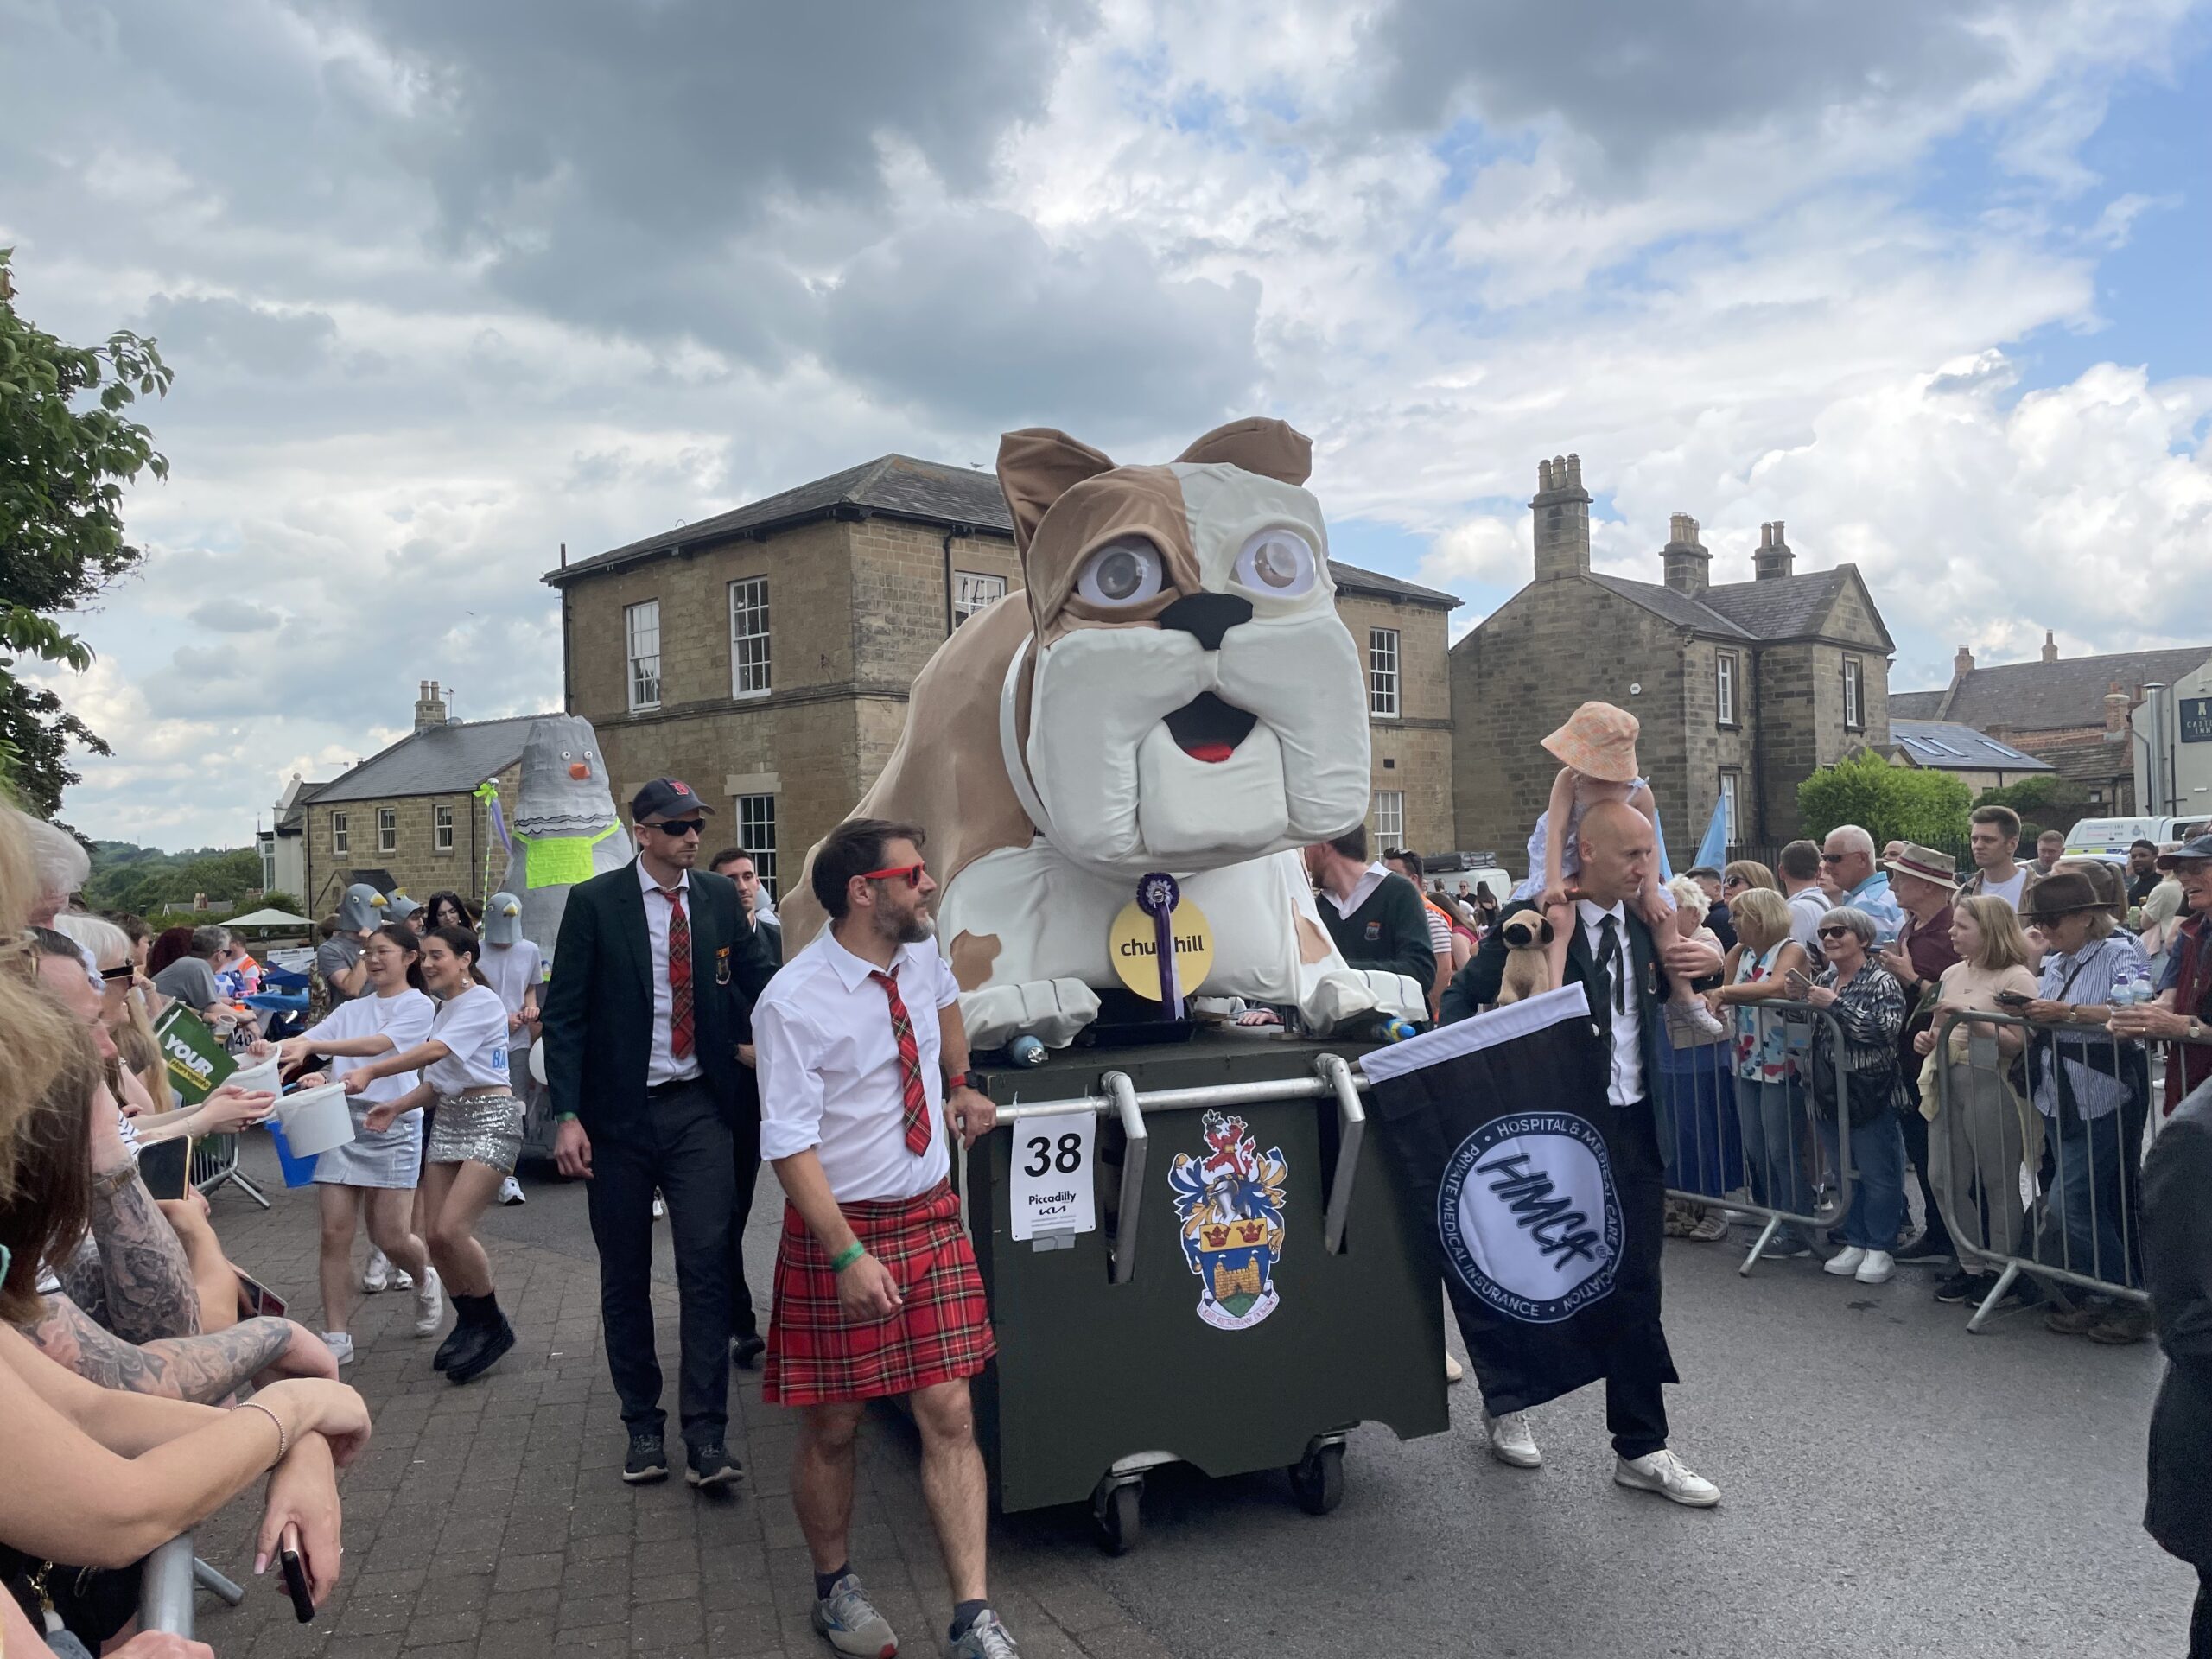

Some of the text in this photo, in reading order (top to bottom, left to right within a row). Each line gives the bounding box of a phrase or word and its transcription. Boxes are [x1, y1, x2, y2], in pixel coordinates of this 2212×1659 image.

[1120, 934, 1205, 957] chuhill
[164, 1033, 213, 1078] YOUR
[1024, 1133, 1081, 1177] 38
[1028, 1191, 1077, 1205] Piccadilly
[1475, 1153, 1600, 1272] HMCA
[1497, 1118, 1620, 1312] HOSPITAL & MEDICAL CARE ACIATION
[1443, 1143, 1541, 1317] PRIVATE MEDICAL INSURANCE
